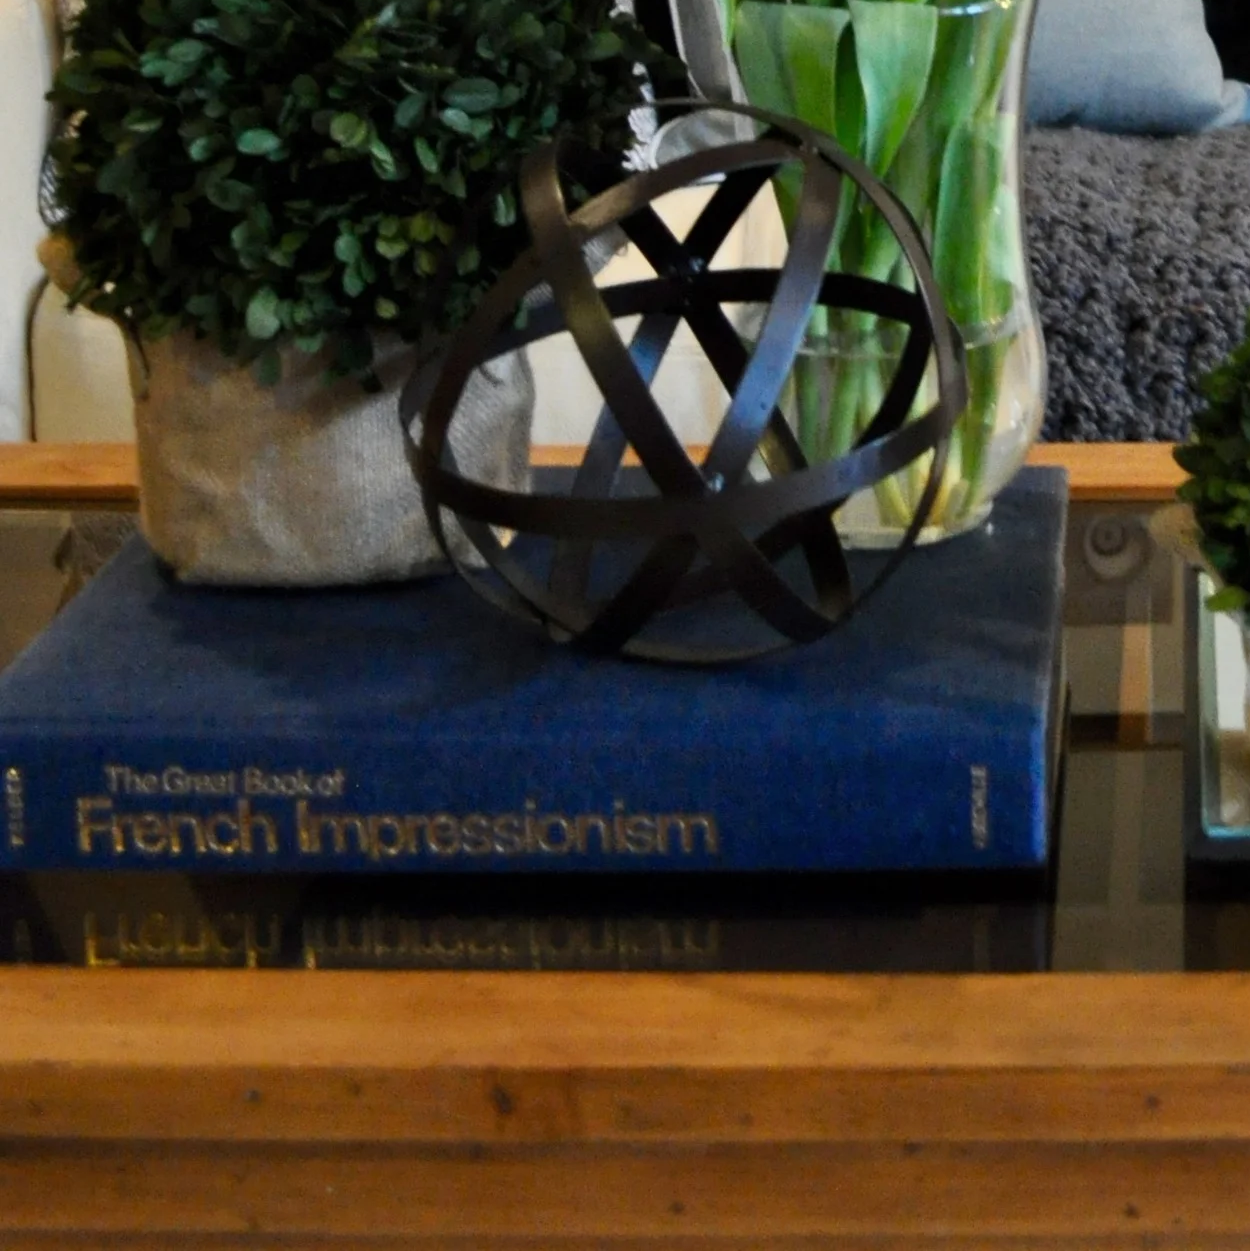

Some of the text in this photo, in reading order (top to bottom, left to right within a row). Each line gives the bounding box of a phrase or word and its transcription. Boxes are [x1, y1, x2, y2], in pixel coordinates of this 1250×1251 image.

[105, 764, 345, 797] The Great Book of
[76, 796, 278, 853] French
[297, 799, 718, 861] Impressionism
